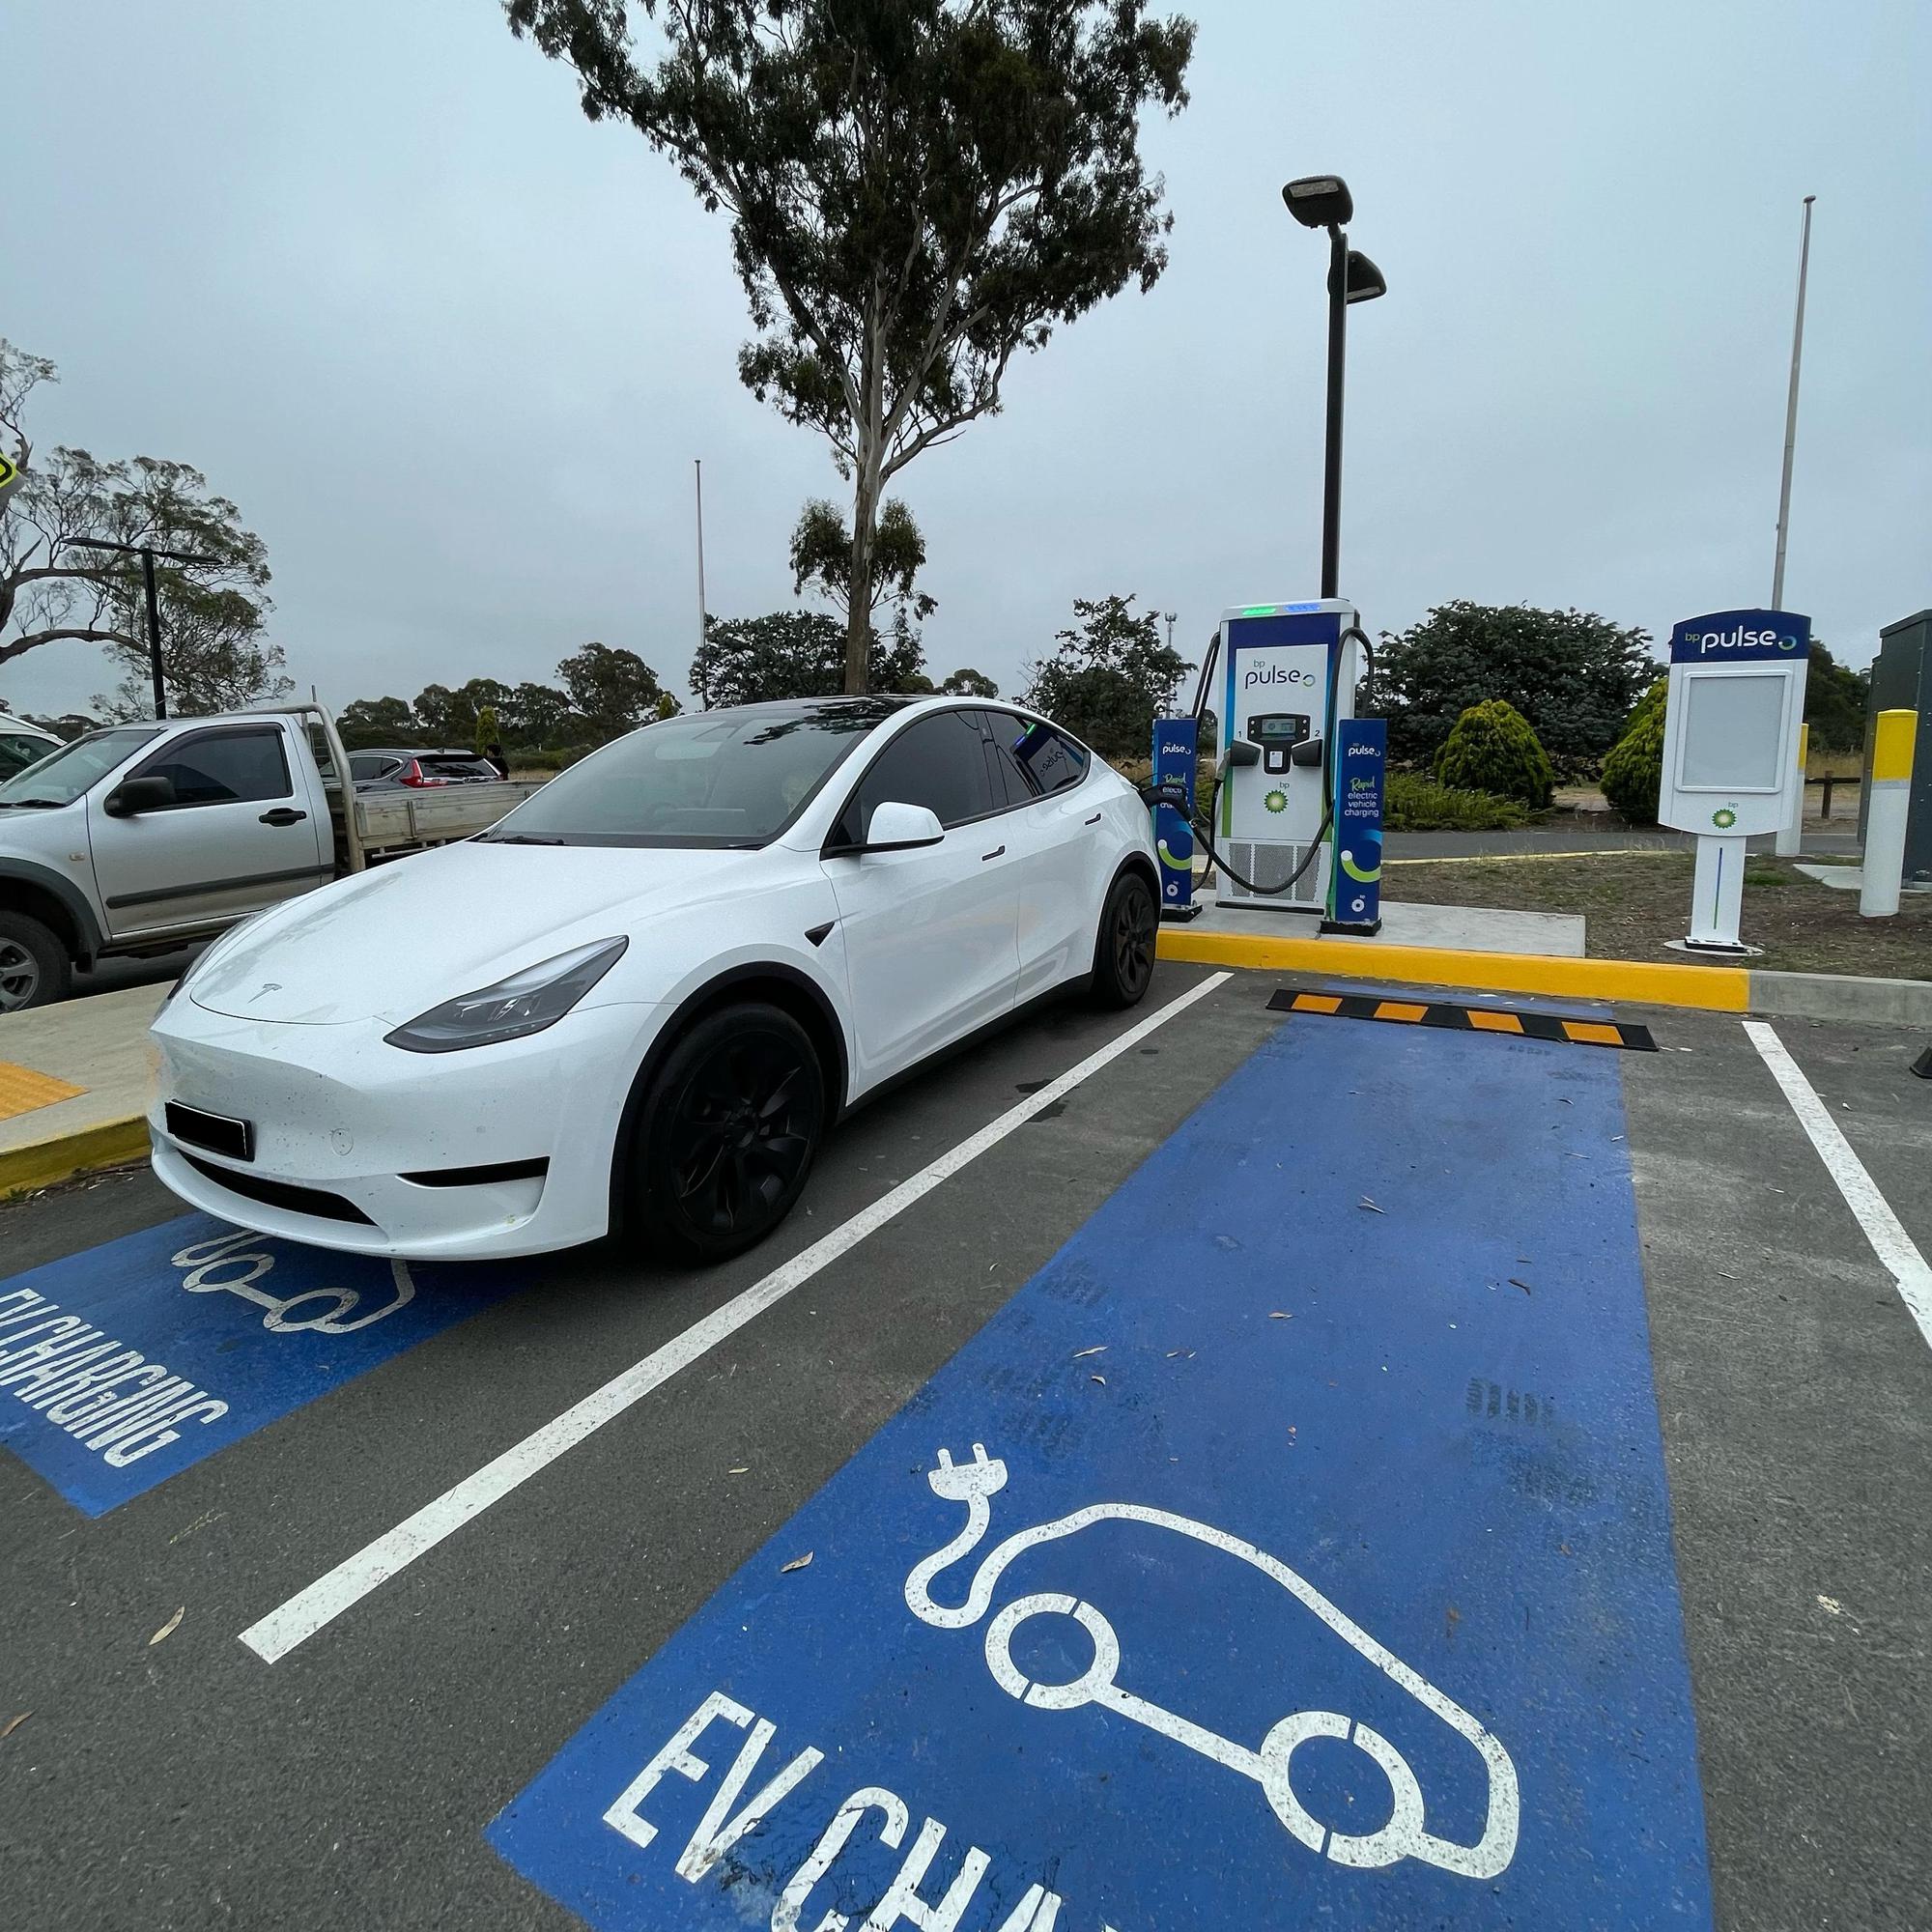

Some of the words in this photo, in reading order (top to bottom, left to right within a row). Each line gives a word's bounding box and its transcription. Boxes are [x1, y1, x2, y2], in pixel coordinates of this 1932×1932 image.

[1685, 632, 1700, 643] bp
[1700, 625, 1777, 654] pulse
[1253, 659, 1265, 668] bp
[1244, 665, 1301, 690] pulse
[1162, 743, 1186, 755] pulse
[1348, 745, 1376, 757] pulse
[1350, 776, 1376, 791] Rapid
[1348, 791, 1378, 800] electric
[1348, 800, 1378, 809] vehicle
[1344, 809, 1379, 818] charging
[0, 1315, 229, 1467] CHARGING
[602, 1690, 825, 1884] EV
